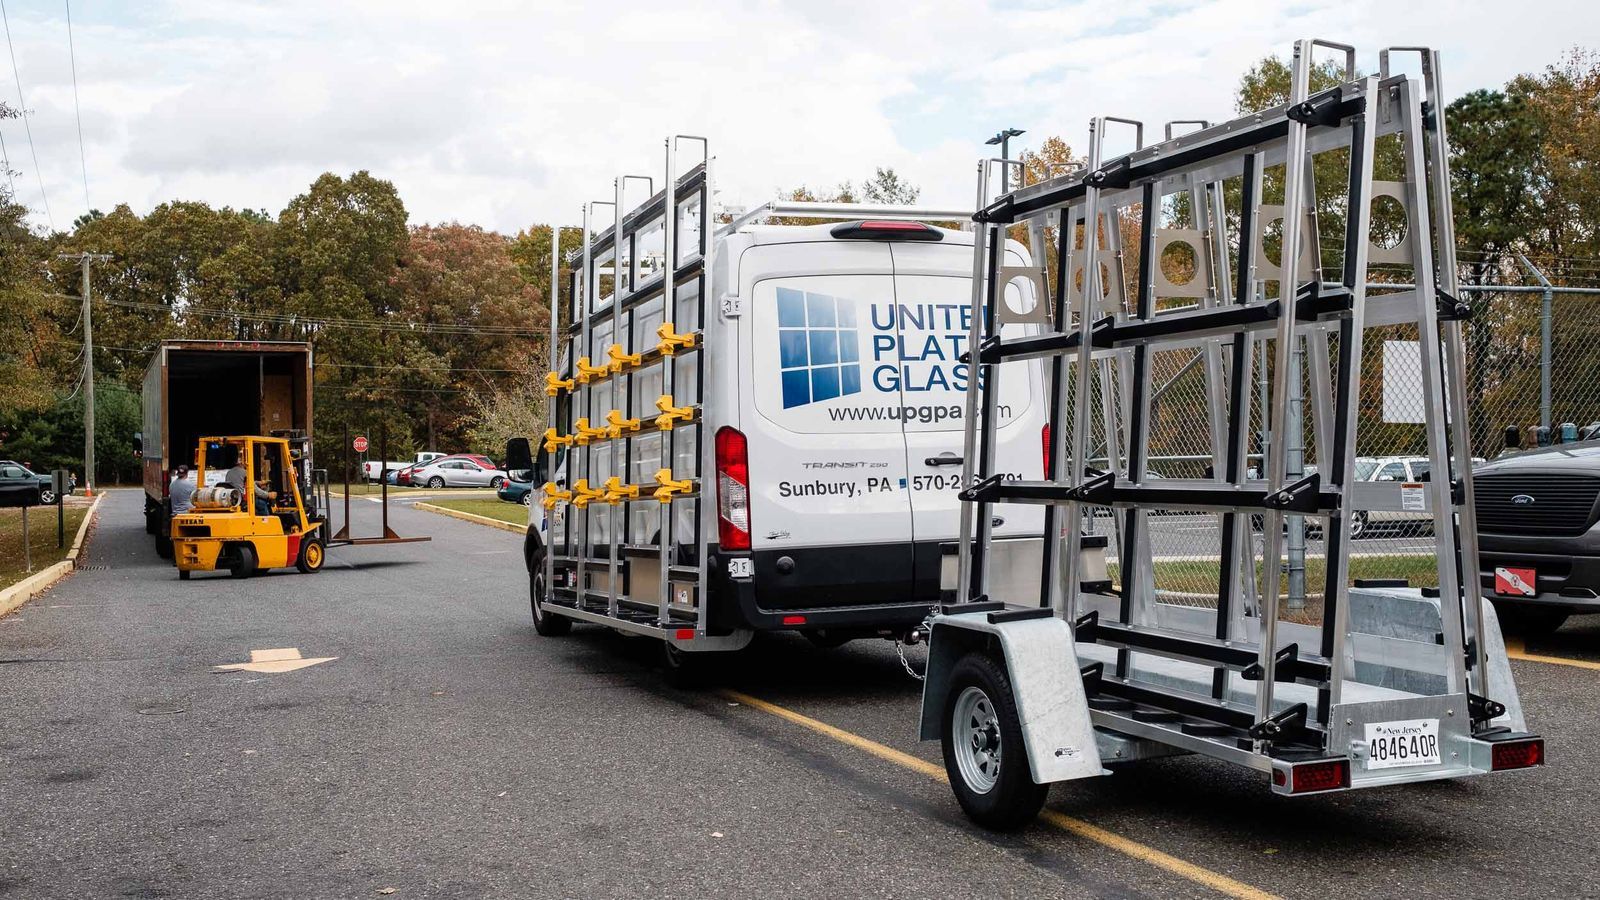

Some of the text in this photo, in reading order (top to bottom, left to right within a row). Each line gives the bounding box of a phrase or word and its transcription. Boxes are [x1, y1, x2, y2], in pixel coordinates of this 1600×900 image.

[873, 334, 988, 362] PLAT
[828, 404, 1012, 423] www.upgpa.m
[801, 461, 867, 469] TRANSIT
[779, 480, 862, 498] Sunbury,
[867, 476, 893, 493] PA
[1387, 726, 1423, 735] New Jersey
